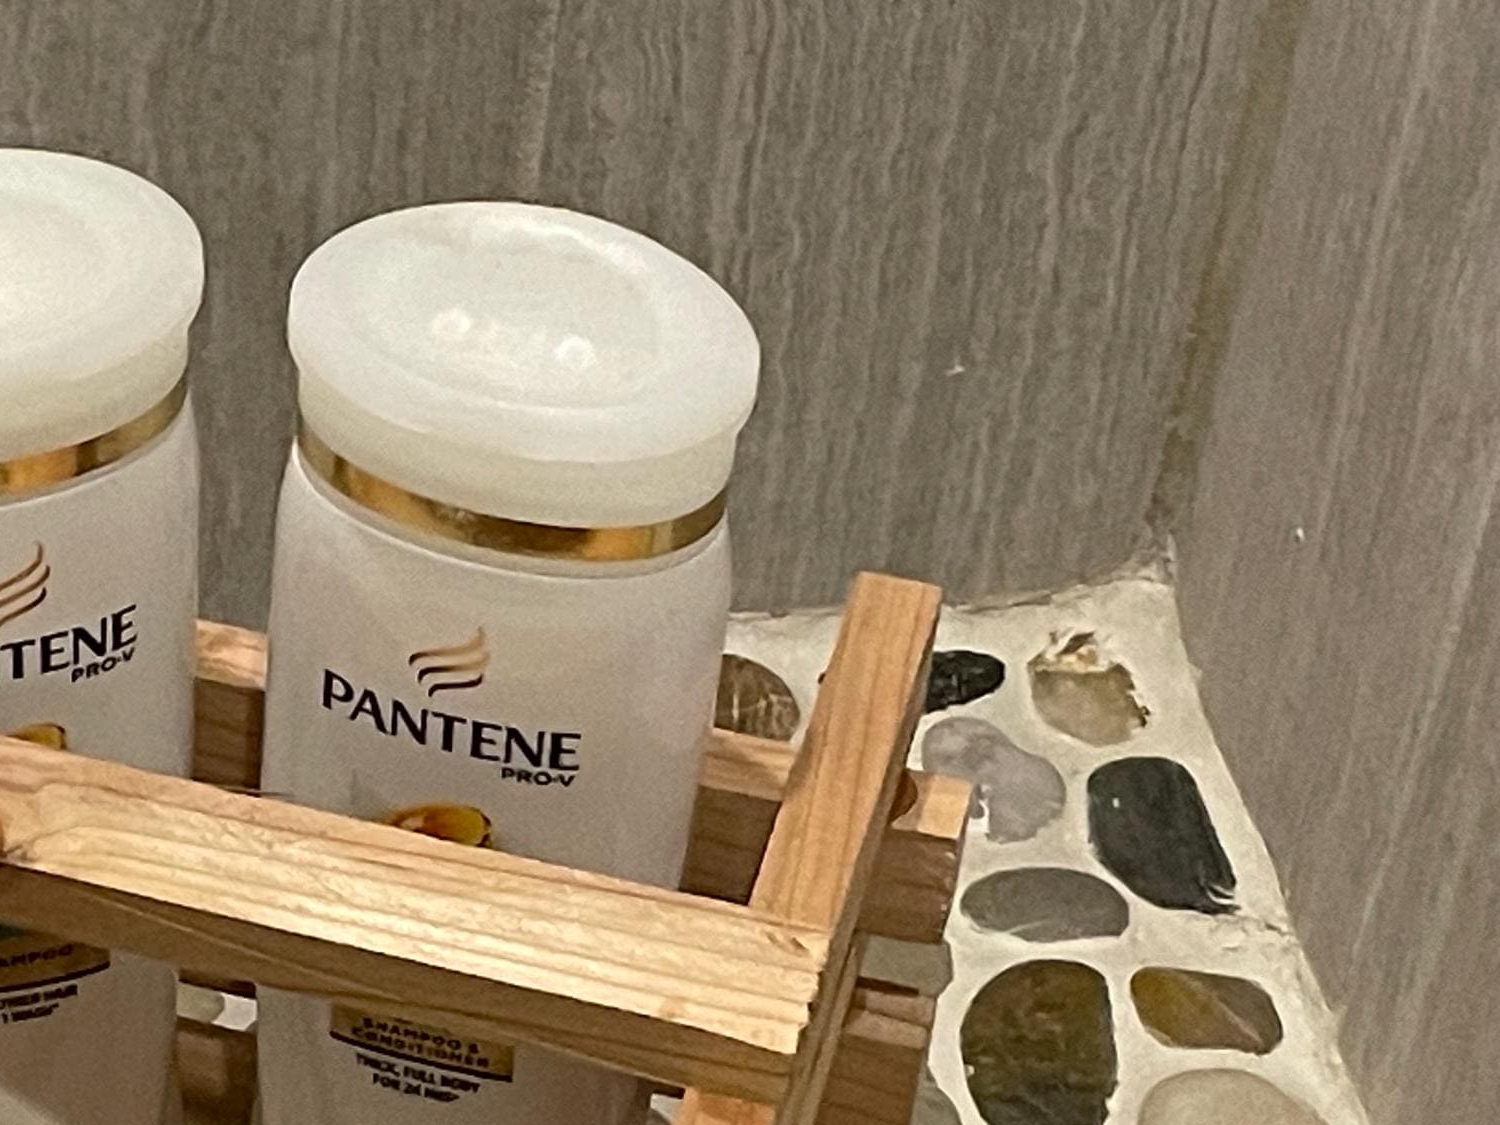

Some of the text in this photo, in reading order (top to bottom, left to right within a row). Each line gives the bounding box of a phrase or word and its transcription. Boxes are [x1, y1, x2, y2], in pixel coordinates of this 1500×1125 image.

[71, 647, 136, 683] PRO-V
[321, 668, 582, 772] PANTENE
[501, 766, 576, 788] PRO-V
[361, 1016, 463, 1051] SHAMPOO
[372, 1072, 401, 1091] FOR
[403, 1064, 437, 1085] FULL
